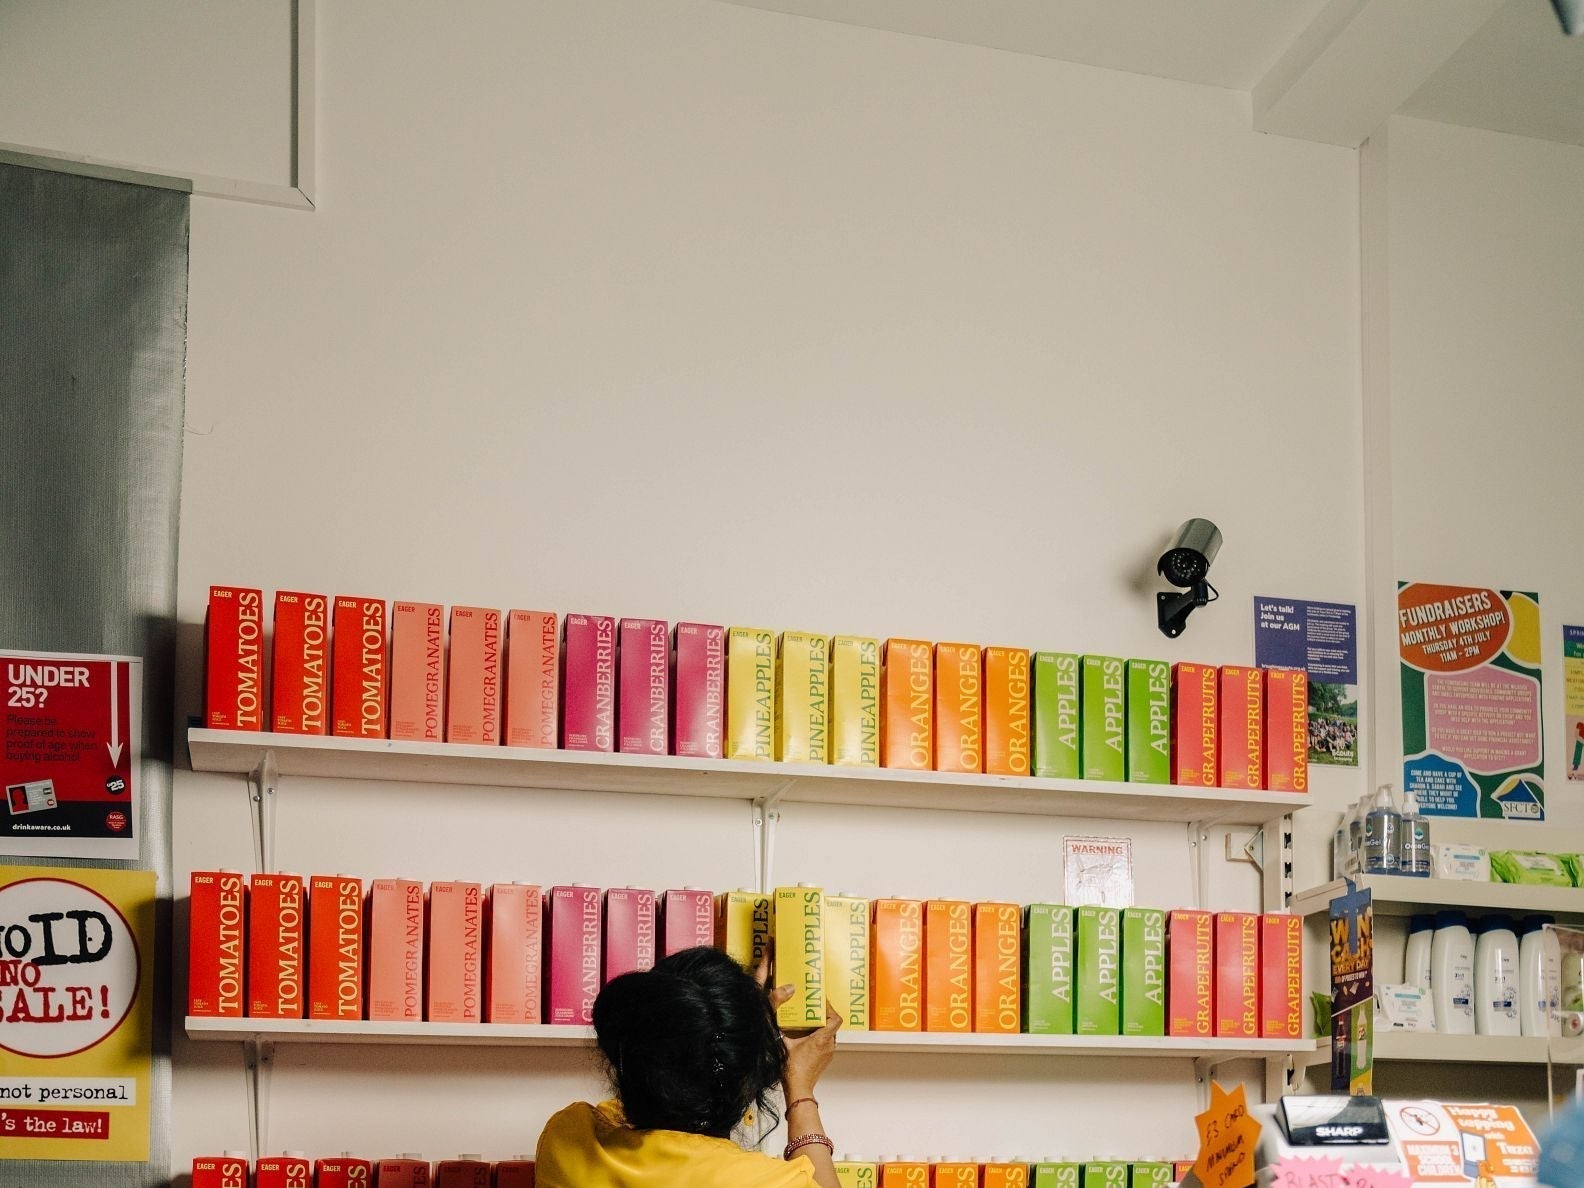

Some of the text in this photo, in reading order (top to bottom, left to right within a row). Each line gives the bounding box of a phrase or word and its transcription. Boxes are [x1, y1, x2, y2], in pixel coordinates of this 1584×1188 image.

[214, 590, 232, 598] EAGER
[280, 595, 298, 603] EAGER
[338, 600, 356, 608] EAGER
[398, 605, 415, 613] EAGER
[455, 610, 472, 618] EAGER
[570, 618, 587, 626] EAGER
[1260, 604, 1277, 612] Let's
[1261, 612, 1274, 620] Join
[1399, 592, 1491, 627] FUNDRAISERS
[1401, 612, 1505, 647] MONTHLY WORKSHOP!
[8, 664, 90, 687] UNDER
[237, 592, 258, 726] TOMATOES
[302, 597, 324, 731] TOMATOES
[362, 602, 382, 734] TOMATOES
[426, 608, 440, 738] POMEGRANATES
[482, 612, 498, 742] POMEGRANATES
[542, 616, 556, 745] POMEGRANATES
[596, 620, 612, 749] CRANBERRIES
[650, 624, 665, 752] CRANBERRIES
[1226, 668, 1239, 676] EAGER
[1422, 632, 1491, 655] THURSDAY 4TH JULY
[1440, 646, 1480, 662] 11AM 2PM
[7, 714, 56, 725] Please be
[7, 728, 54, 740] prepared
[8, 687, 47, 708] 25?
[706, 628, 722, 756] CRANBERRIES
[756, 633, 772, 758] PINEAPPLES
[810, 637, 825, 761] PINEAPPLES
[861, 641, 876, 764] PINEAPPLES
[910, 644, 929, 767] ORANGES
[960, 647, 978, 770] ORANGES
[1008, 650, 1027, 772] ORANGES
[1056, 657, 1076, 750] APPLES
[1104, 660, 1122, 753] APPLES
[1149, 664, 1167, 756] APPLES
[1202, 668, 1214, 786] GRAPEFRUITS
[1248, 671, 1260, 788] GRAPEFRUITS
[1293, 673, 1304, 790] GRAPEFRUITS
[6, 740, 97, 752] proof of age when
[6, 752, 80, 763] buying alcohol
[1071, 844, 1123, 856] WARNING
[1504, 804, 1528, 813] SFCT
[0, 959, 41, 987] NO
[28, 910, 113, 966] ID
[218, 877, 240, 1013] TOMATOES
[278, 880, 299, 1015] TOMATOES
[339, 882, 358, 1016] TOMATOES
[405, 886, 419, 1017] POMEGRANATES
[464, 887, 477, 1018] POMEGRANATES
[524, 889, 539, 1020] POMEGRANATES
[582, 891, 597, 1022] CRANBERRIES
[804, 891, 822, 1022] PINEAPPLES
[850, 901, 866, 1026] PINEAPPLES
[900, 904, 918, 1028] ORANGES
[950, 905, 968, 1028] ORANGES
[999, 908, 1017, 1029] ORANGES
[1052, 909, 1070, 1003] APPLES
[1099, 911, 1116, 1005] APPLES
[1144, 913, 1162, 1006] APPLES
[1197, 915, 1210, 1034] GRAPEFRUITS
[1242, 916, 1255, 1035] GRAPEFRUITS
[1287, 918, 1299, 1036] GRAPEFRUITS
[1333, 959, 1368, 974] EVERY DAY
[0, 985, 110, 1023] ALE!
[0, 1084, 128, 1102] not personal
[24, 1116, 102, 1133] the law!
[1206, 1104, 1244, 1147] £3 CARD
[1316, 1126, 1364, 1136] SHARP
[1447, 1107, 1498, 1119] Happy
[1206, 1135, 1244, 1172] MINIMUM
[1451, 1145, 1459, 1155] 2
